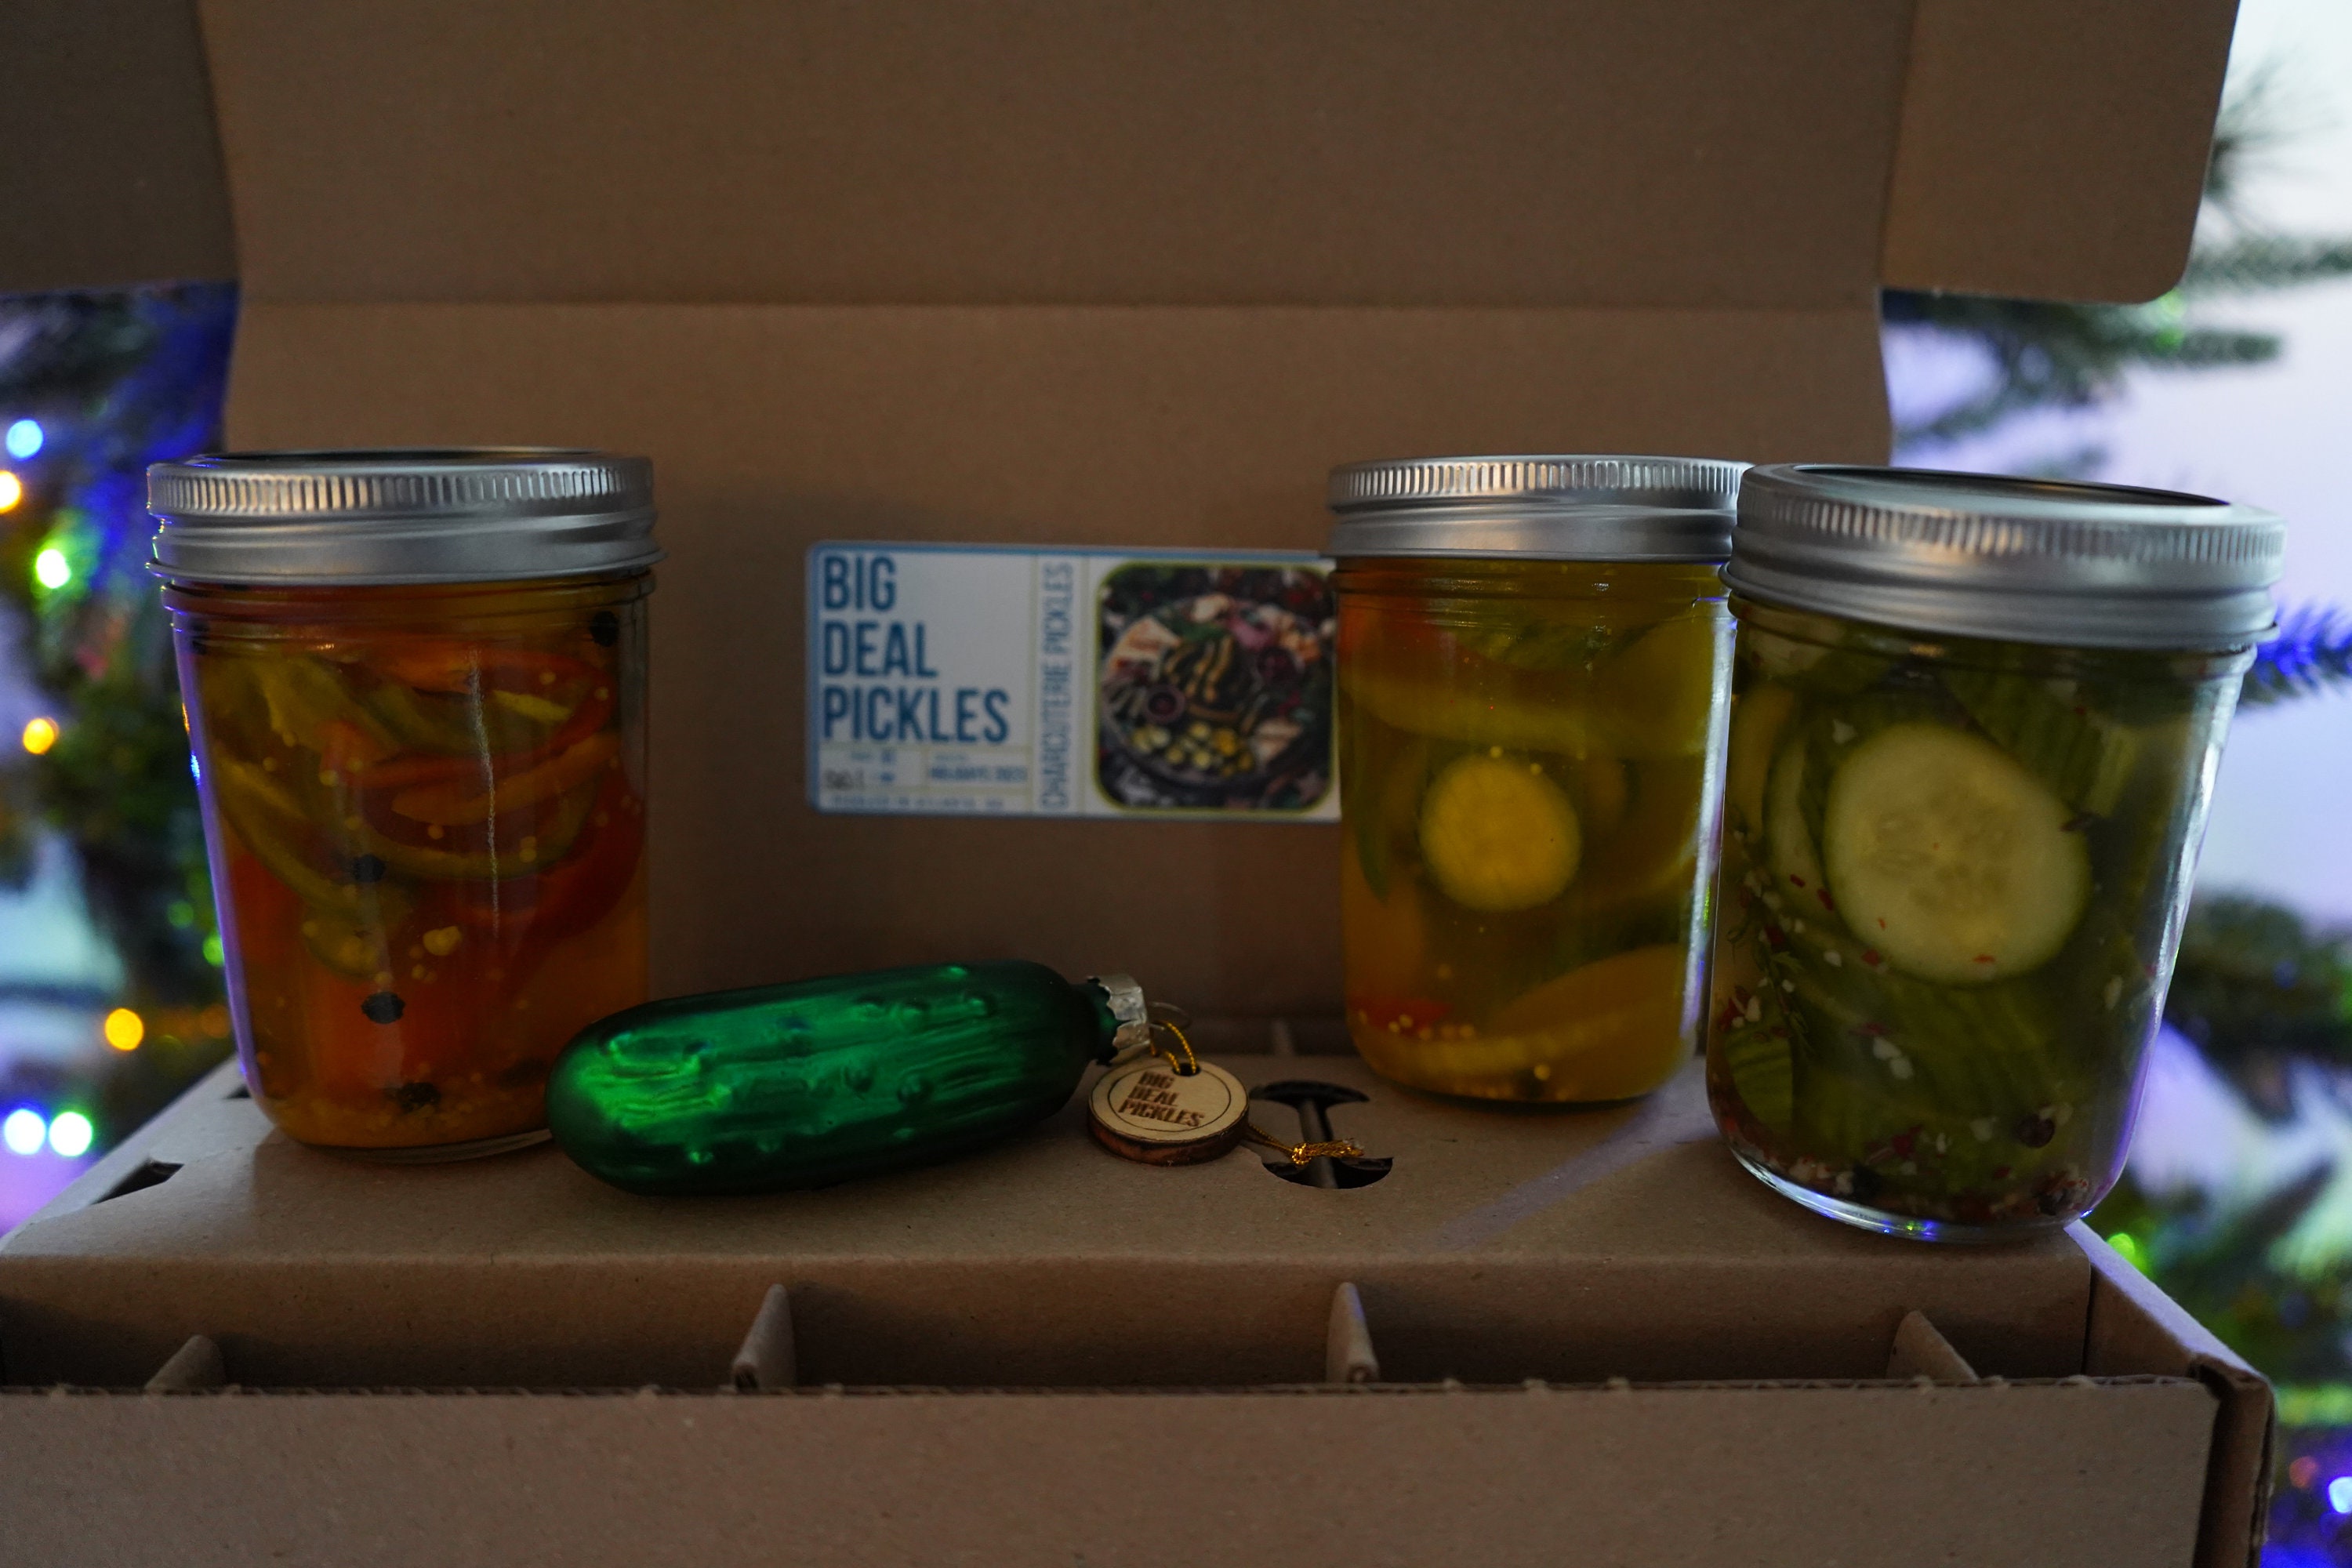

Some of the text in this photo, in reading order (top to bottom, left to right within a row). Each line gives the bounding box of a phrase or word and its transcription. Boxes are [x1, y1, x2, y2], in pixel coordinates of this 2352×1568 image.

[822, 556, 897, 611] BIG
[822, 620, 938, 678] DEAL
[822, 686, 1010, 744] PICKLES
[1128, 1086, 1181, 1106] DEAL
[1139, 1072, 1174, 1088] BIG
[1118, 1099, 1205, 1127] PICKLES
